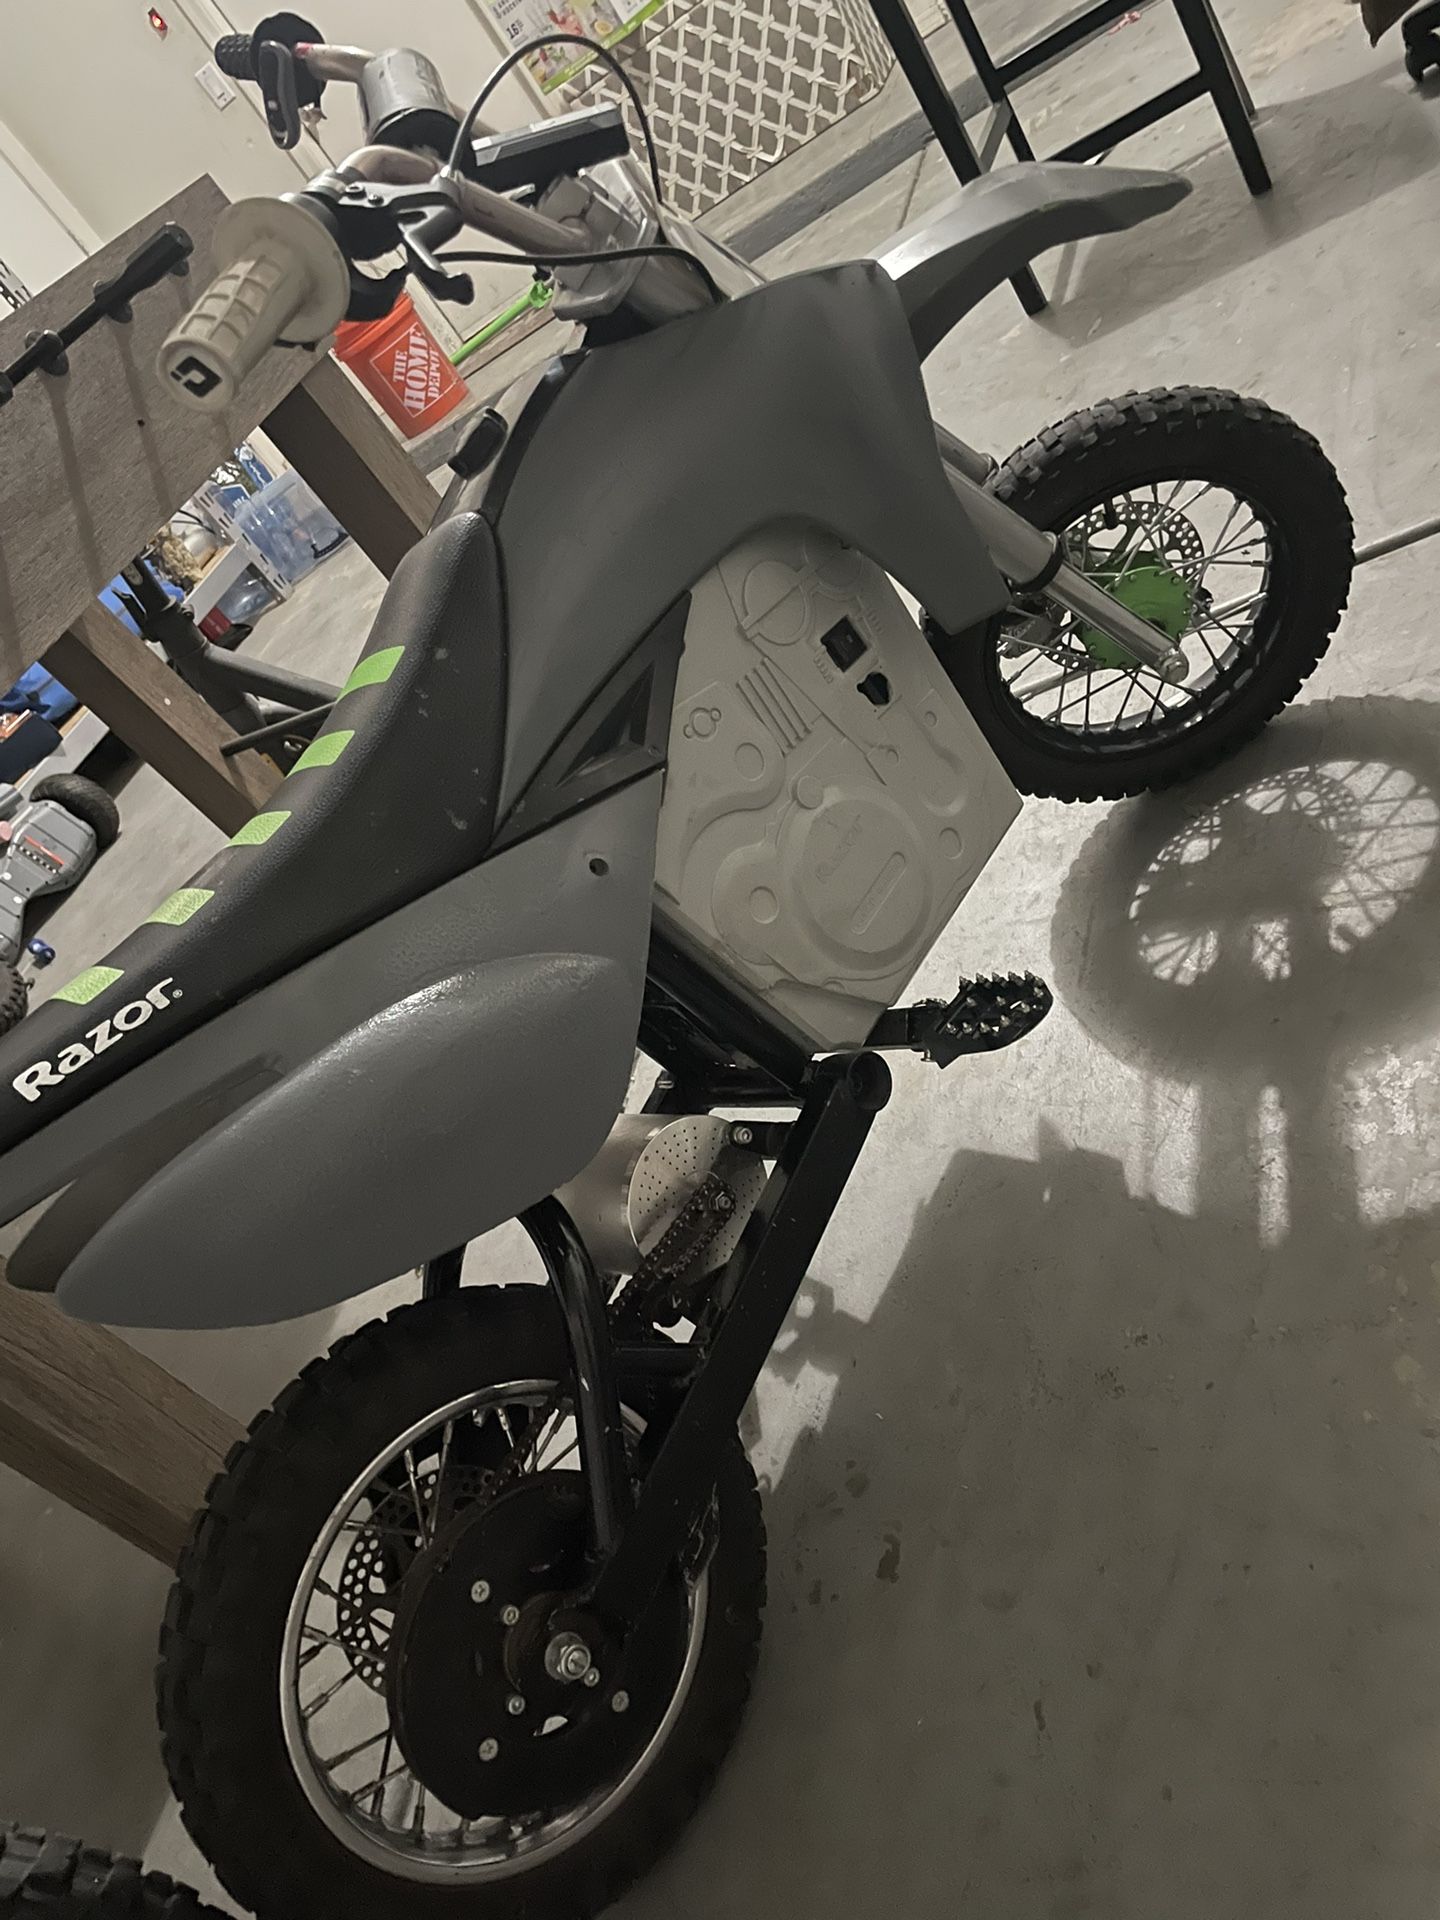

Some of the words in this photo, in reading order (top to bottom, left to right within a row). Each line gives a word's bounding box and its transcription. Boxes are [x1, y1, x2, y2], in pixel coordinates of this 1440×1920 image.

[393, 350, 408, 382] THE
[403, 328, 429, 410] HOME
[427, 346, 441, 399] DEPOT
